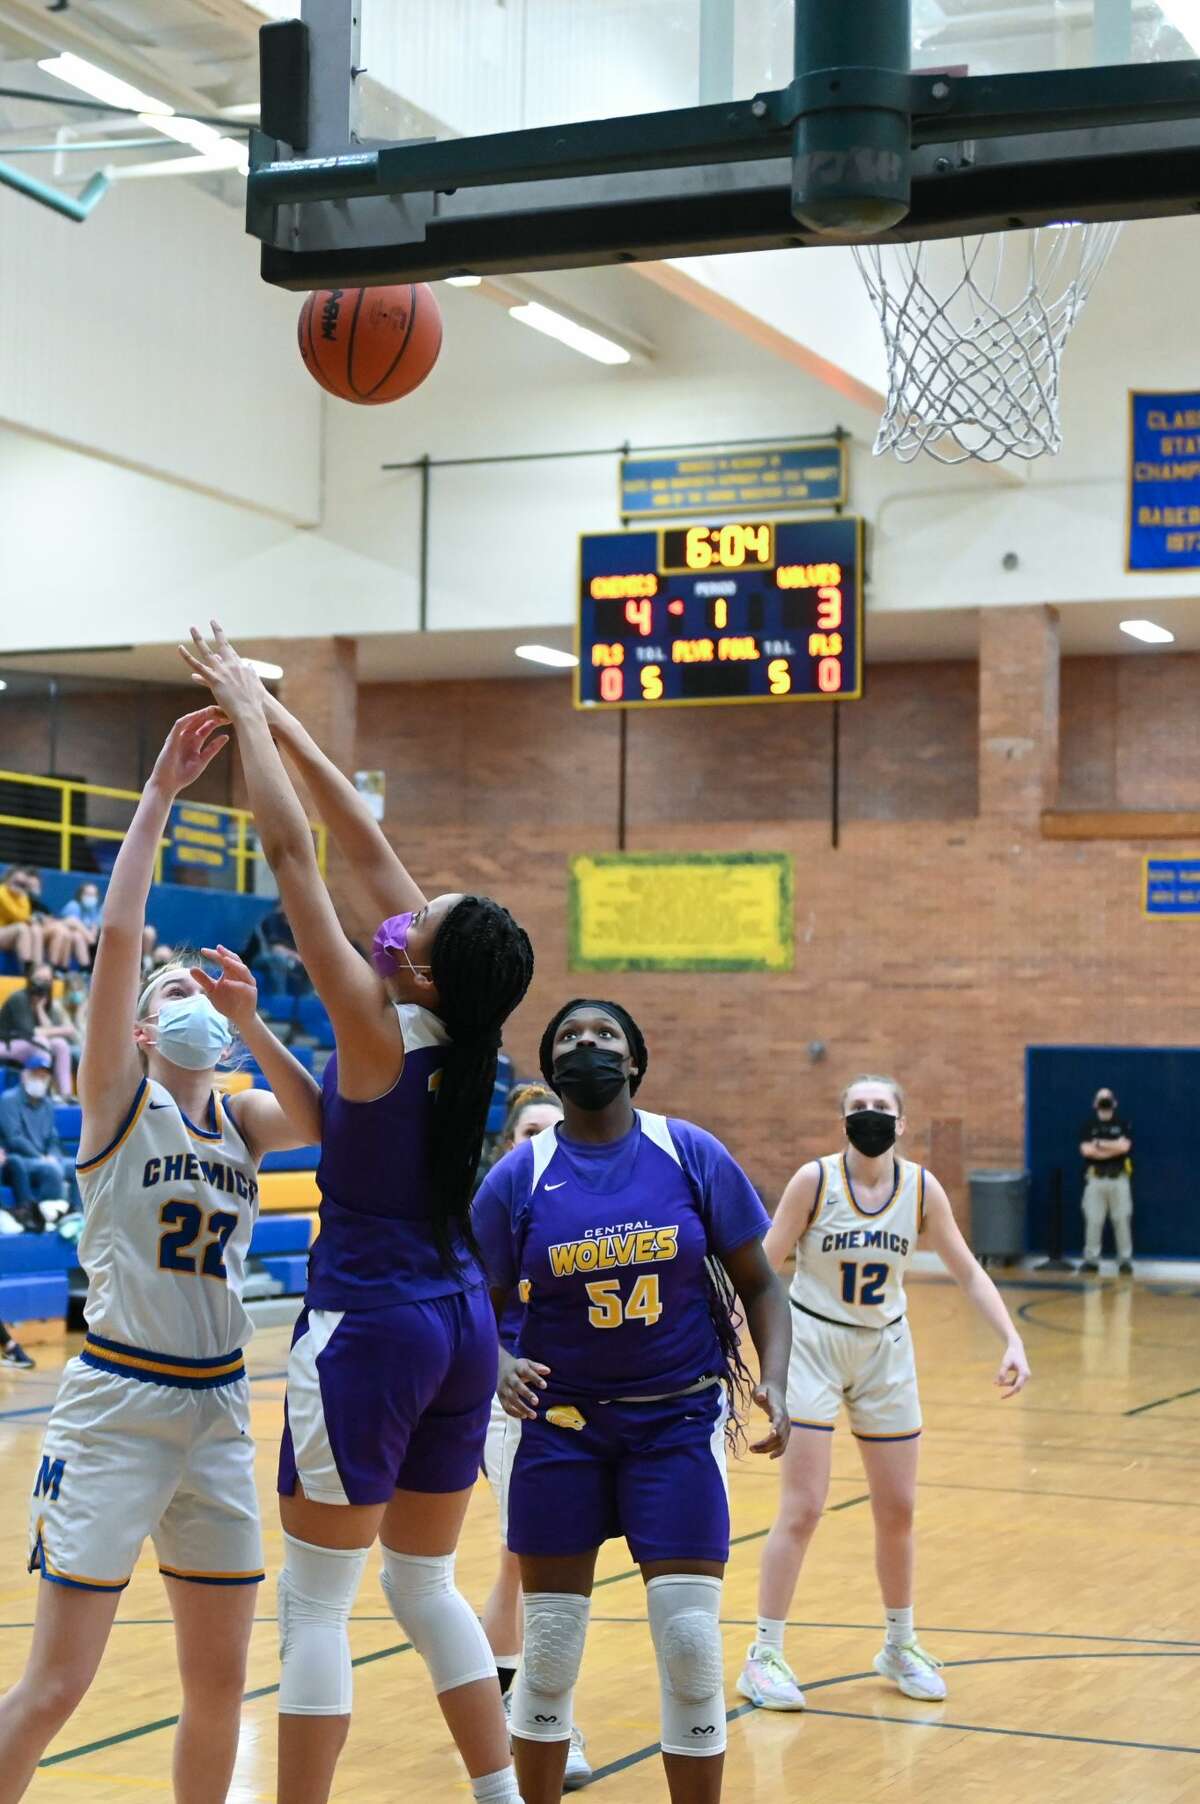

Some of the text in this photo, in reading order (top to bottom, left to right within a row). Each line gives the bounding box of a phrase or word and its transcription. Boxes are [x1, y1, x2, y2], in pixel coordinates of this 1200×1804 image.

[1147, 410, 1200, 430] CLAS
[685, 524, 770, 569] 6:04
[624, 598, 652, 636] 4
[714, 597, 728, 629] 1
[816, 587, 842, 630] 3
[600, 666, 623, 702] 0
[640, 665, 663, 700] 5
[767, 658, 791, 695] 5
[818, 657, 842, 693] 0
[157, 1198, 240, 1280] 22
[584, 1220, 652, 1238] CENTRAL
[821, 1230, 909, 1256] CHEMICS
[548, 1225, 679, 1277] WOLVES
[585, 1273, 663, 1329] 54
[839, 1260, 890, 1306] 12
[33, 1455, 67, 1501] M
